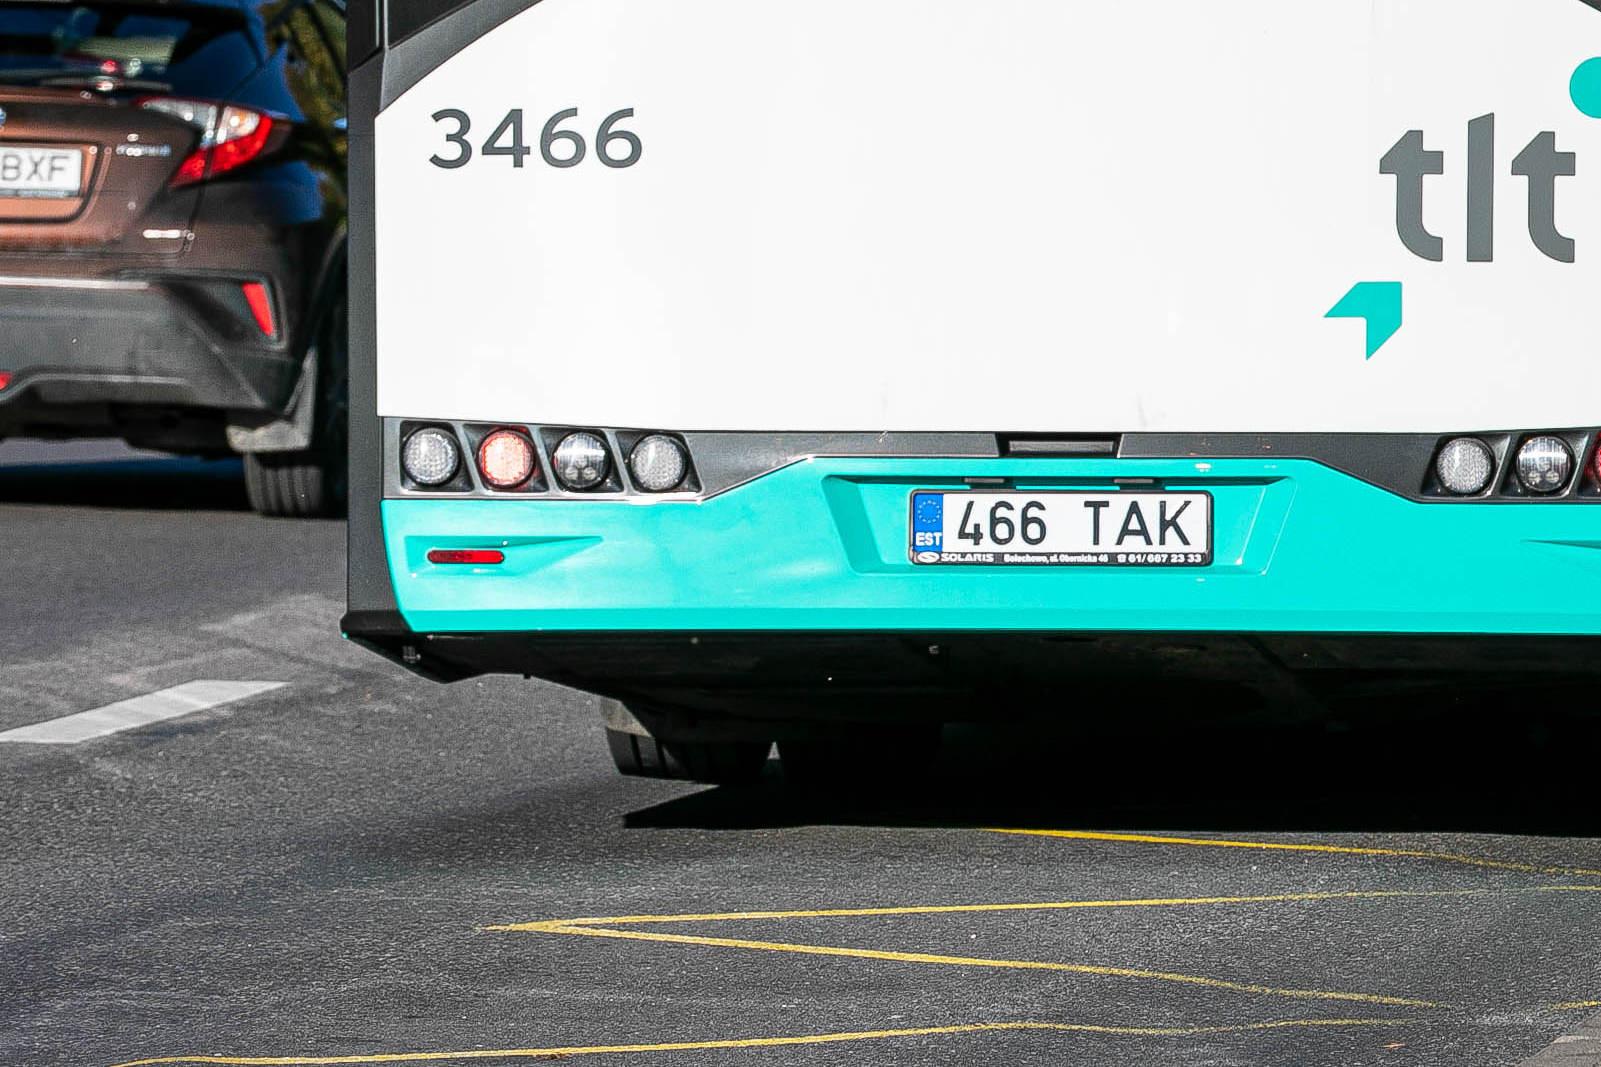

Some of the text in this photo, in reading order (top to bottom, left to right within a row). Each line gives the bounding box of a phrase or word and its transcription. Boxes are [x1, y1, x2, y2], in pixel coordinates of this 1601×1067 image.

[428, 107, 643, 169] 3466
[1379, 112, 1576, 263] tlt
[915, 532, 942, 546] EST
[957, 500, 1192, 546] 466 TAK
[940, 553, 994, 562] SOLARIS
[1170, 553, 1185, 563] 23
[1187, 554, 1202, 563] 33
